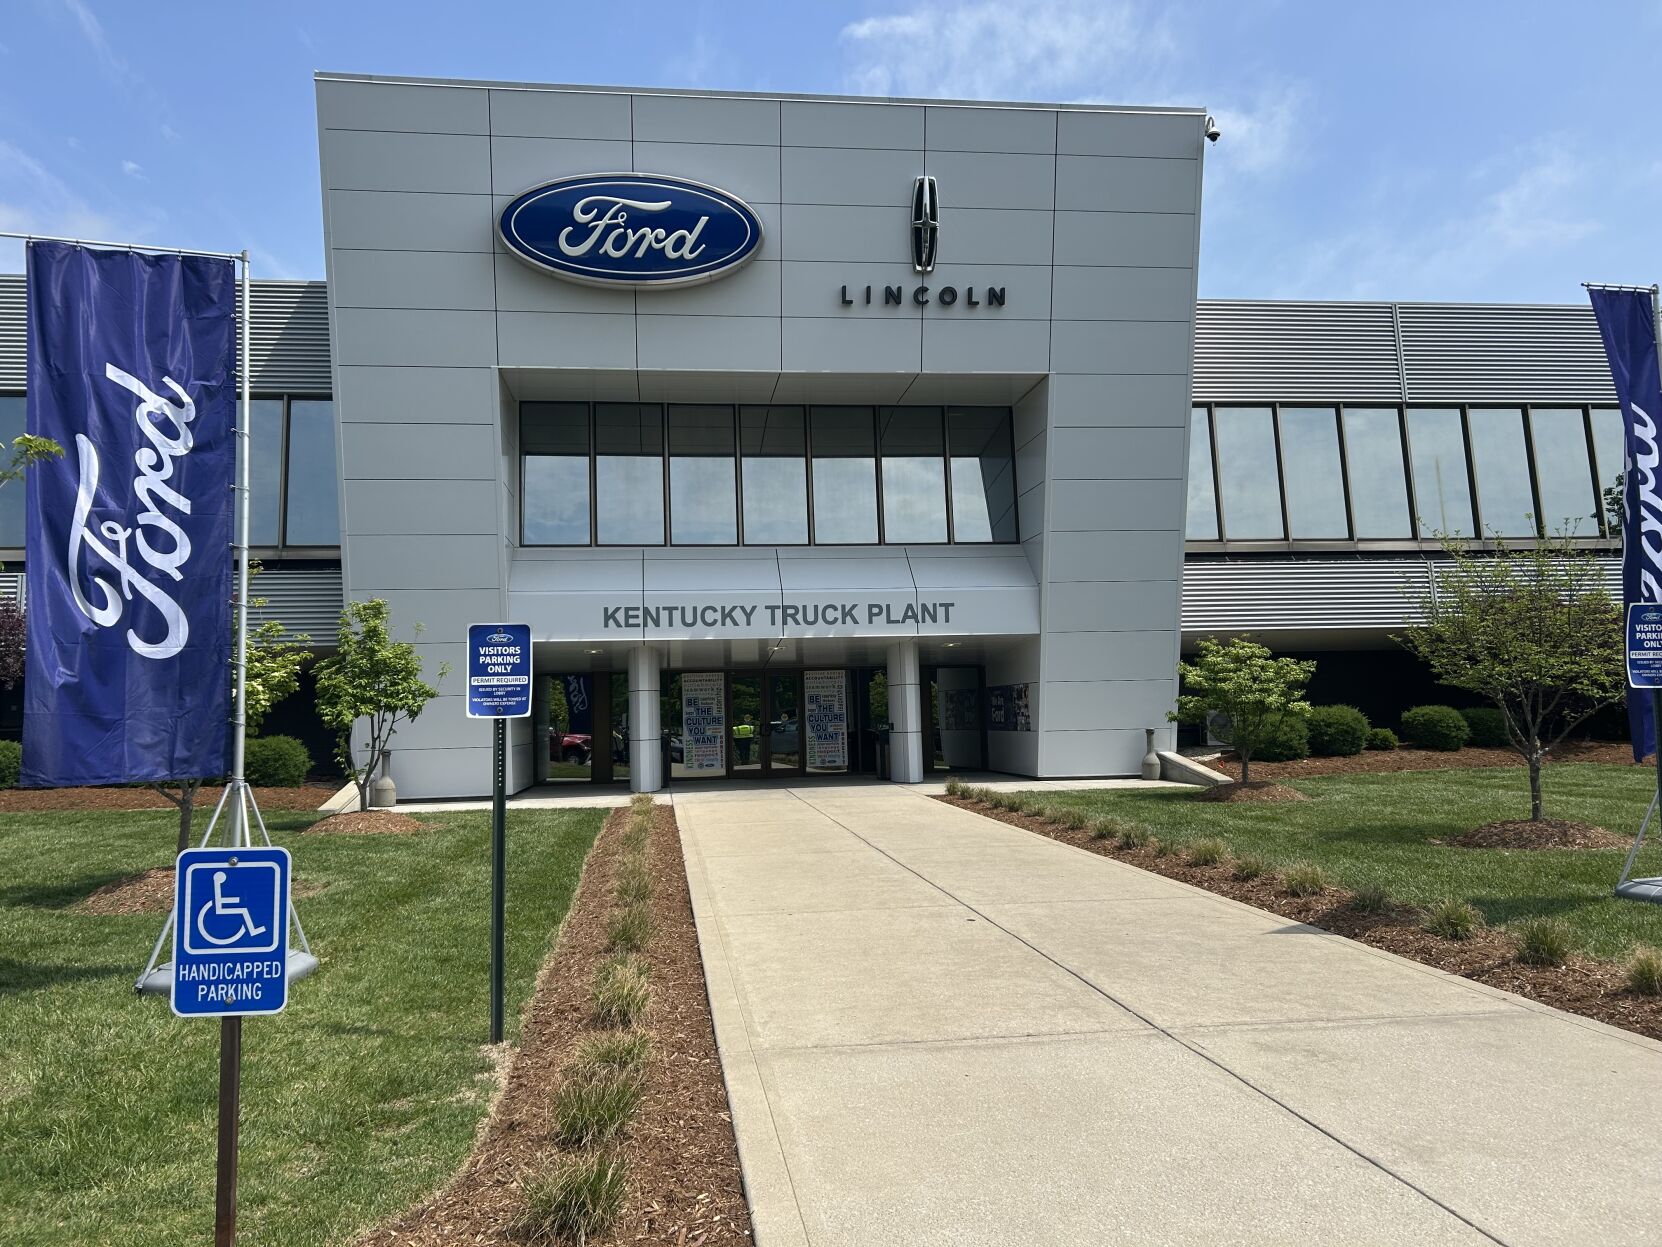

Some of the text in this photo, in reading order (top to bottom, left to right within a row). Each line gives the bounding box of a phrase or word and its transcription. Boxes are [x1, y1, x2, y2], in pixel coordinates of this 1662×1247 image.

[558, 195, 709, 260] Ford
[841, 285, 1006, 306] LINCOLN
[68, 362, 196, 660] Ford
[603, 602, 955, 629] KENTUCKY TRUCK PLANT
[479, 646, 520, 654] VISITORS
[479, 656, 520, 664] PARKING
[487, 665, 512, 673] ONLY
[496, 676, 527, 684] REQUIRED
[687, 698, 698, 706] BE
[809, 695, 820, 703] BE
[696, 707, 712, 715] THE
[818, 704, 833, 712] THE
[687, 717, 723, 725] CULTURE
[808, 714, 844, 722] CULTURE
[688, 727, 705, 735] YOU
[694, 735, 717, 744] WANT
[816, 732, 839, 741] WANT
[179, 961, 281, 981] HANDICAPPED
[198, 983, 262, 1002] PARKING
